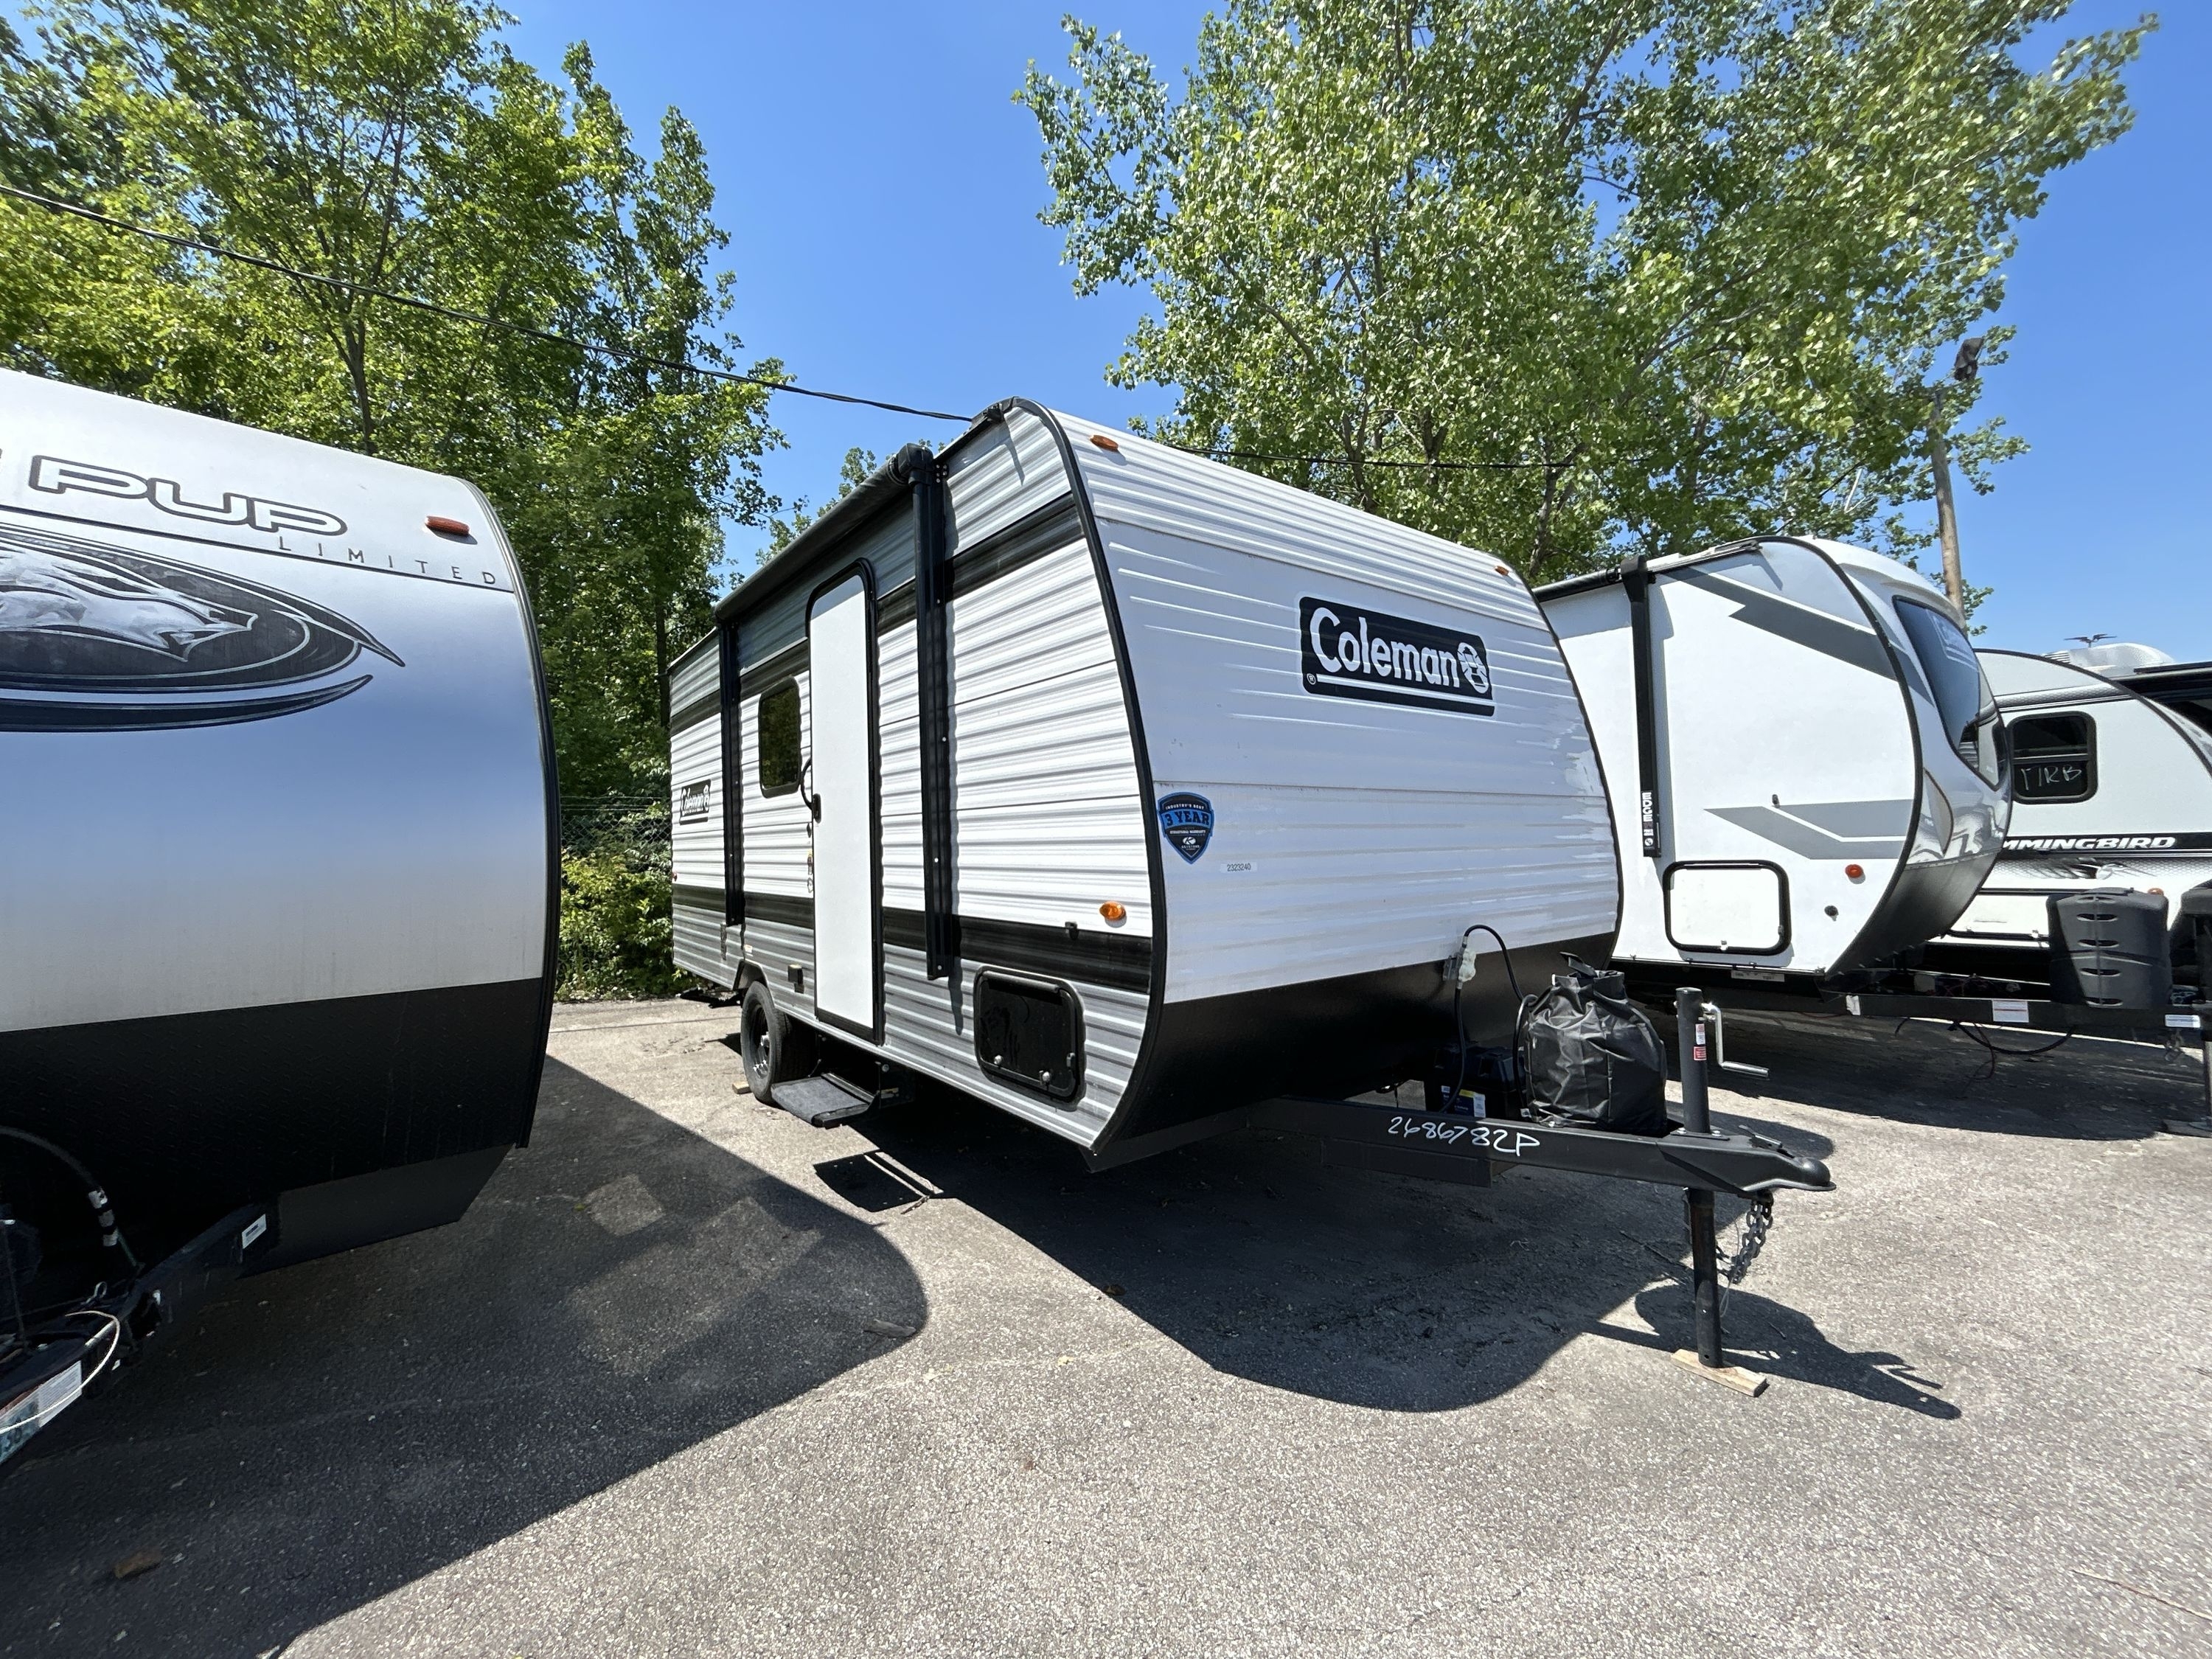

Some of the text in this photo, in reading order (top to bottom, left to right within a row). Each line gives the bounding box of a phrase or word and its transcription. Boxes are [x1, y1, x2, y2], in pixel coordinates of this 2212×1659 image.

[29, 454, 347, 536] PUP
[279, 535, 497, 585] LIMITED
[1310, 607, 1461, 688] Coleman
[1164, 810, 1210, 827] 3 YEAR
[1641, 792, 1653, 822] EDGE
[1226, 863, 1251, 872] 2323240
